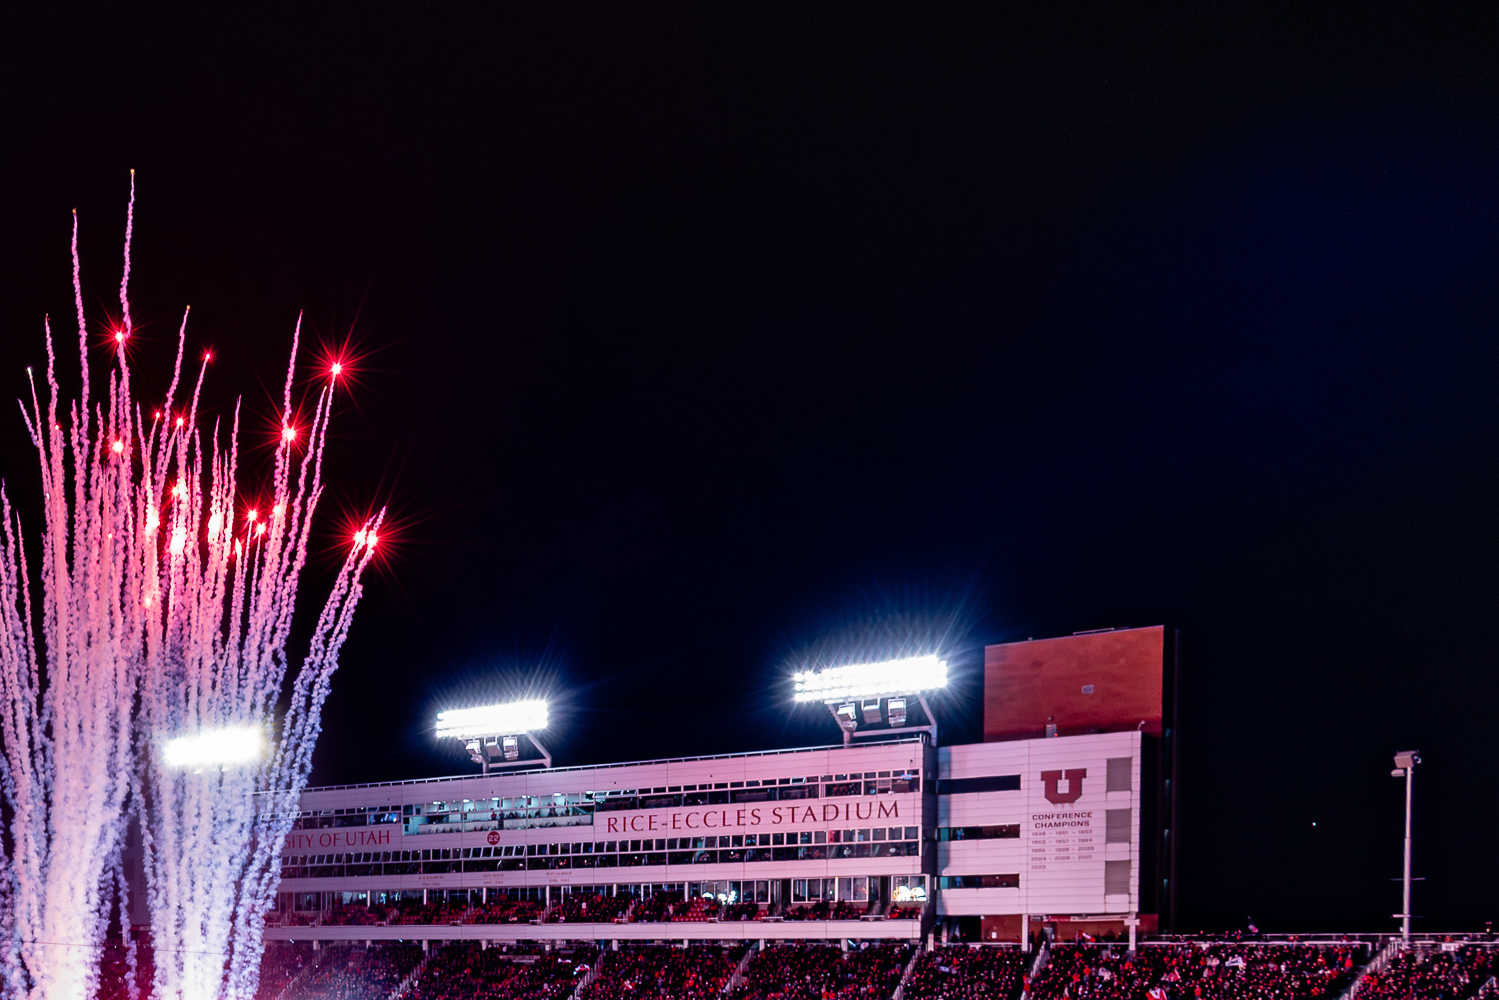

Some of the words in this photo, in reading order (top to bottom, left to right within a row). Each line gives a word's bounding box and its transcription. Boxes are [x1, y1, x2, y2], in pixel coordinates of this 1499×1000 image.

[1040, 768, 1087, 804] U
[606, 808, 762, 834] RICE-ECCLES
[771, 800, 900, 826] STADIUM
[1032, 812, 1093, 821] CONFERENCE
[1034, 820, 1090, 828] CHAMPIONS
[319, 832, 340, 848] OF
[346, 830, 390, 846] UTAH
[488, 834, 500, 843] 22
